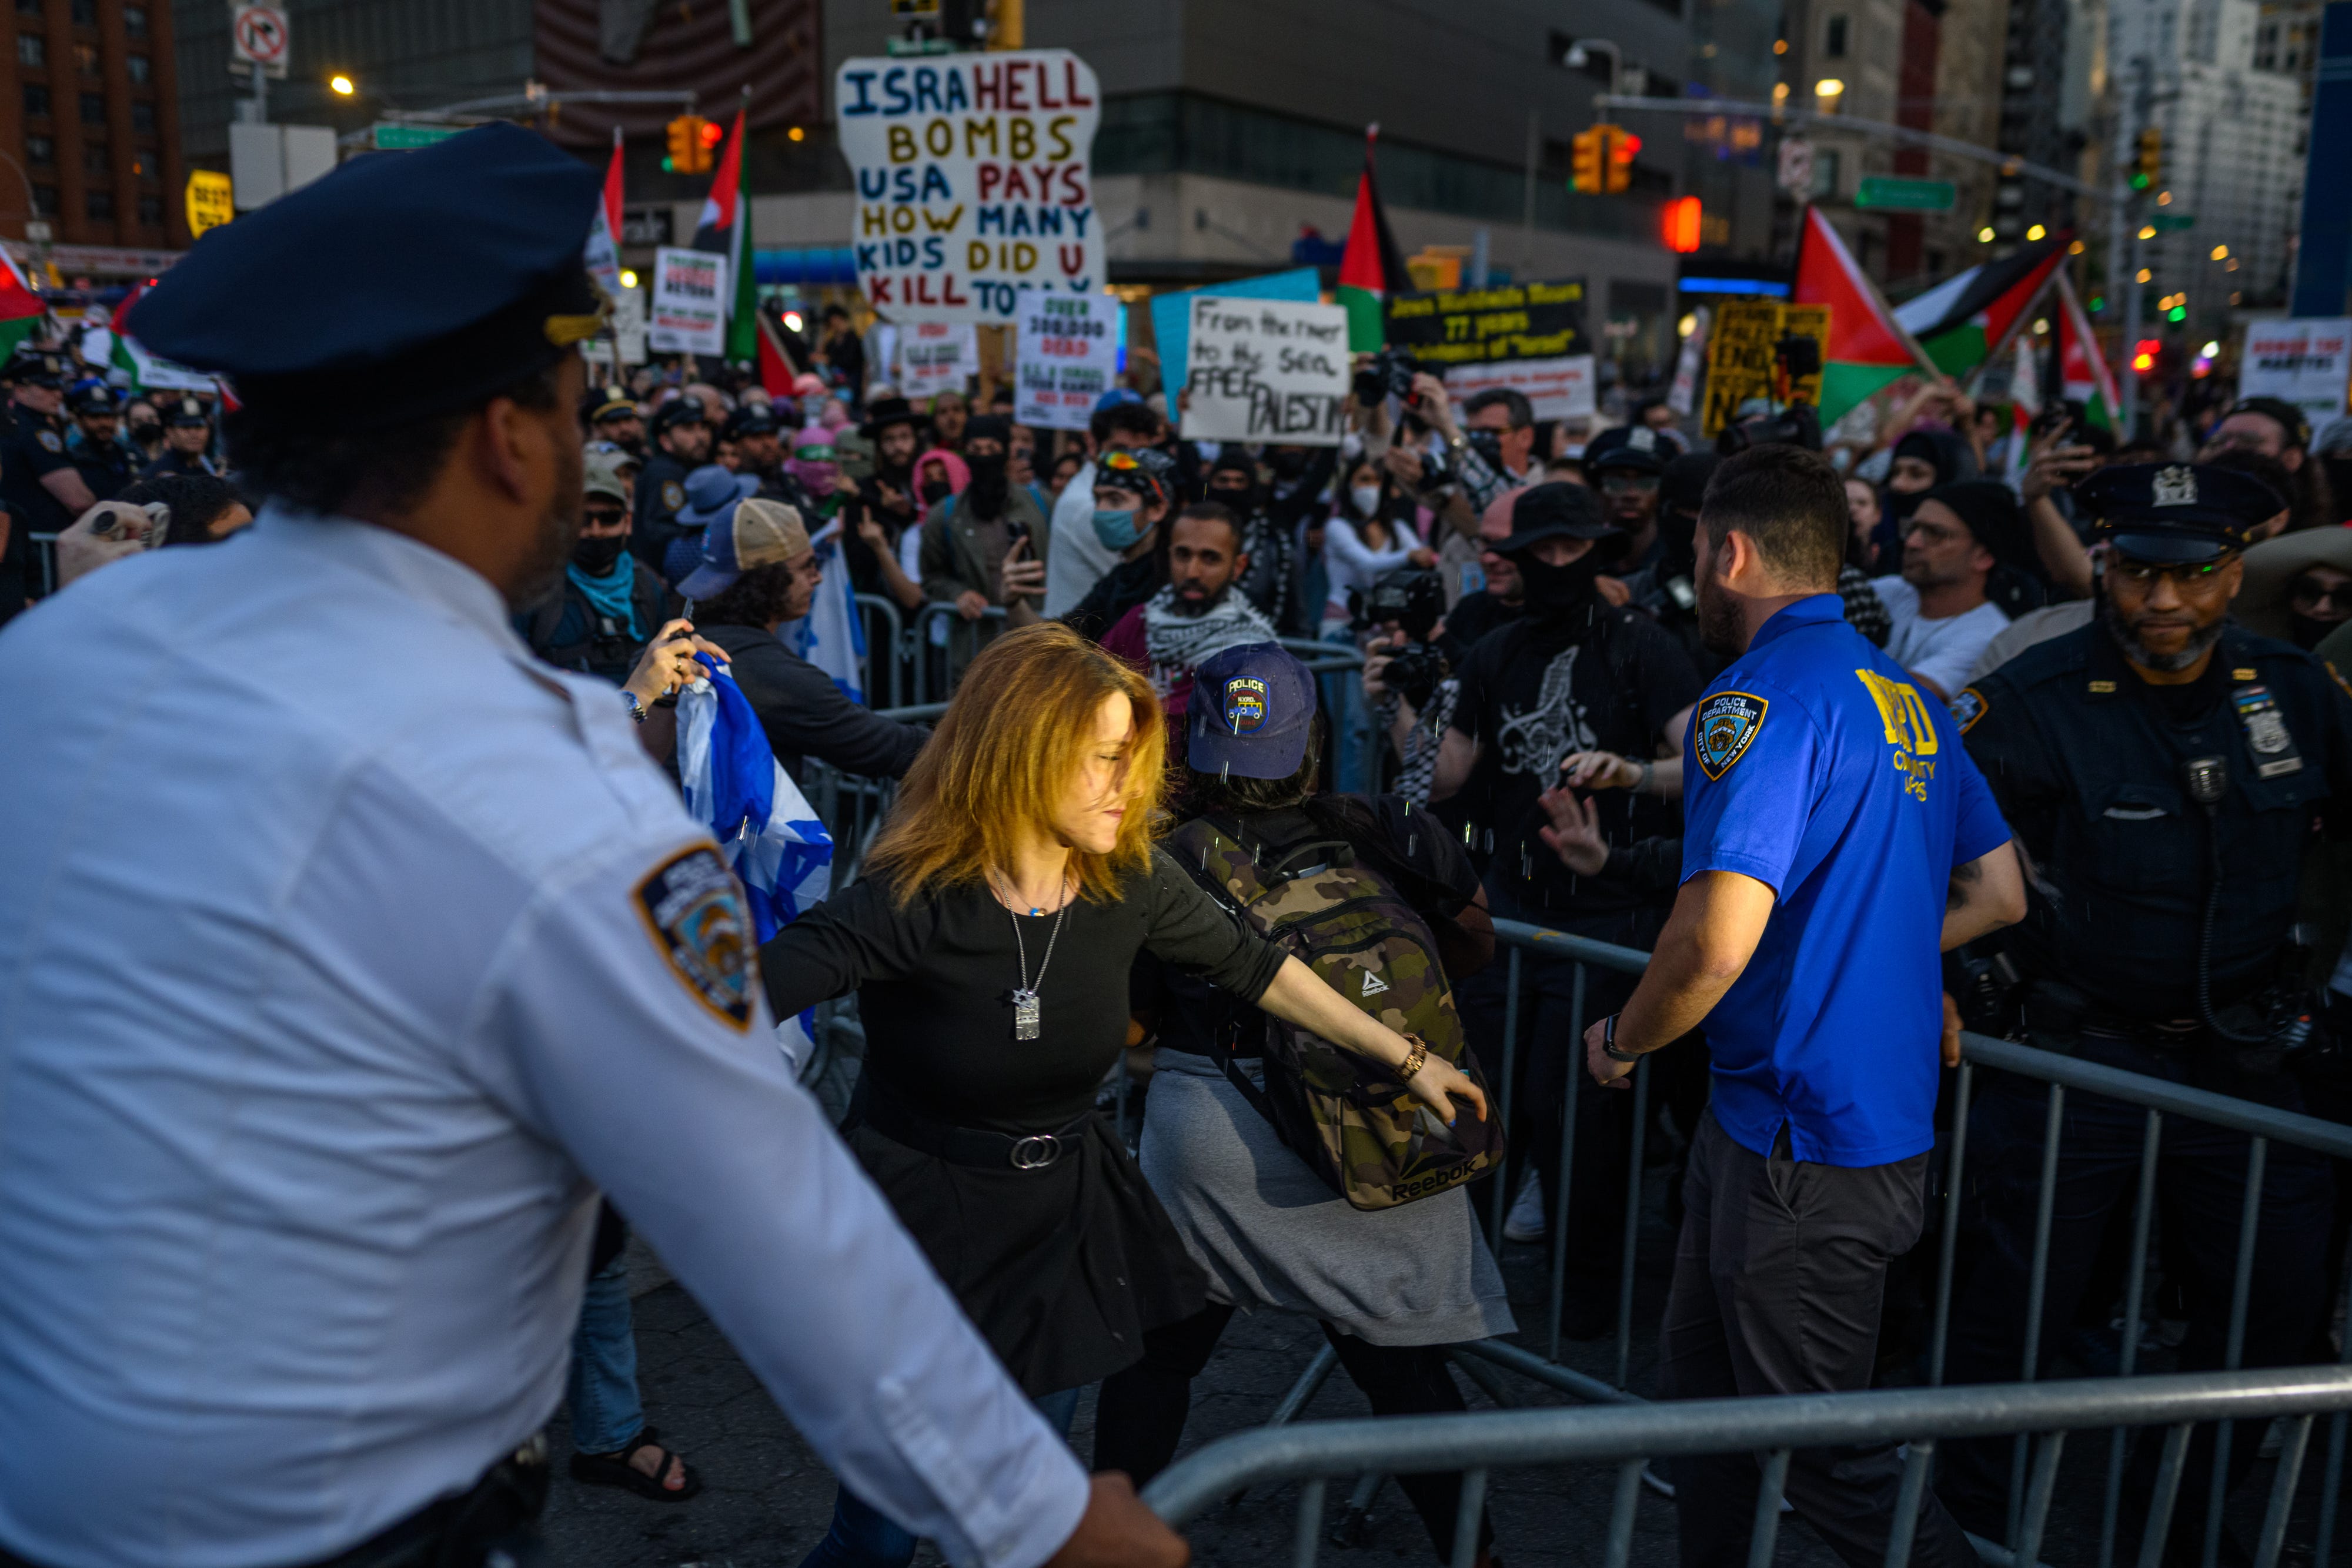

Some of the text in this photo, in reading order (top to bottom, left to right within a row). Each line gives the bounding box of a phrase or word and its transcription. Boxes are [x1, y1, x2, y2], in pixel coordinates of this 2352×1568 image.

[844, 61, 1092, 116] ISRAHELL
[888, 115, 1075, 163] BOMBS
[861, 165, 1085, 205] USA PAYS
[863, 205, 1090, 237] HOW MANY
[858, 237, 1083, 275] KIDS DID U
[871, 273, 967, 306] KILL
[1041, 337, 1090, 357] DEAD
[1228, 678, 1264, 693] POLICE
[1701, 706, 1757, 722] DEPARTMENT
[1713, 697, 1747, 708] POLICE
[1697, 731, 1710, 765] CITY OF
[1720, 724, 1756, 768] NEW YORK
[1361, 985, 1390, 997] Reebok
[1392, 1159, 1476, 1201] Reebok
